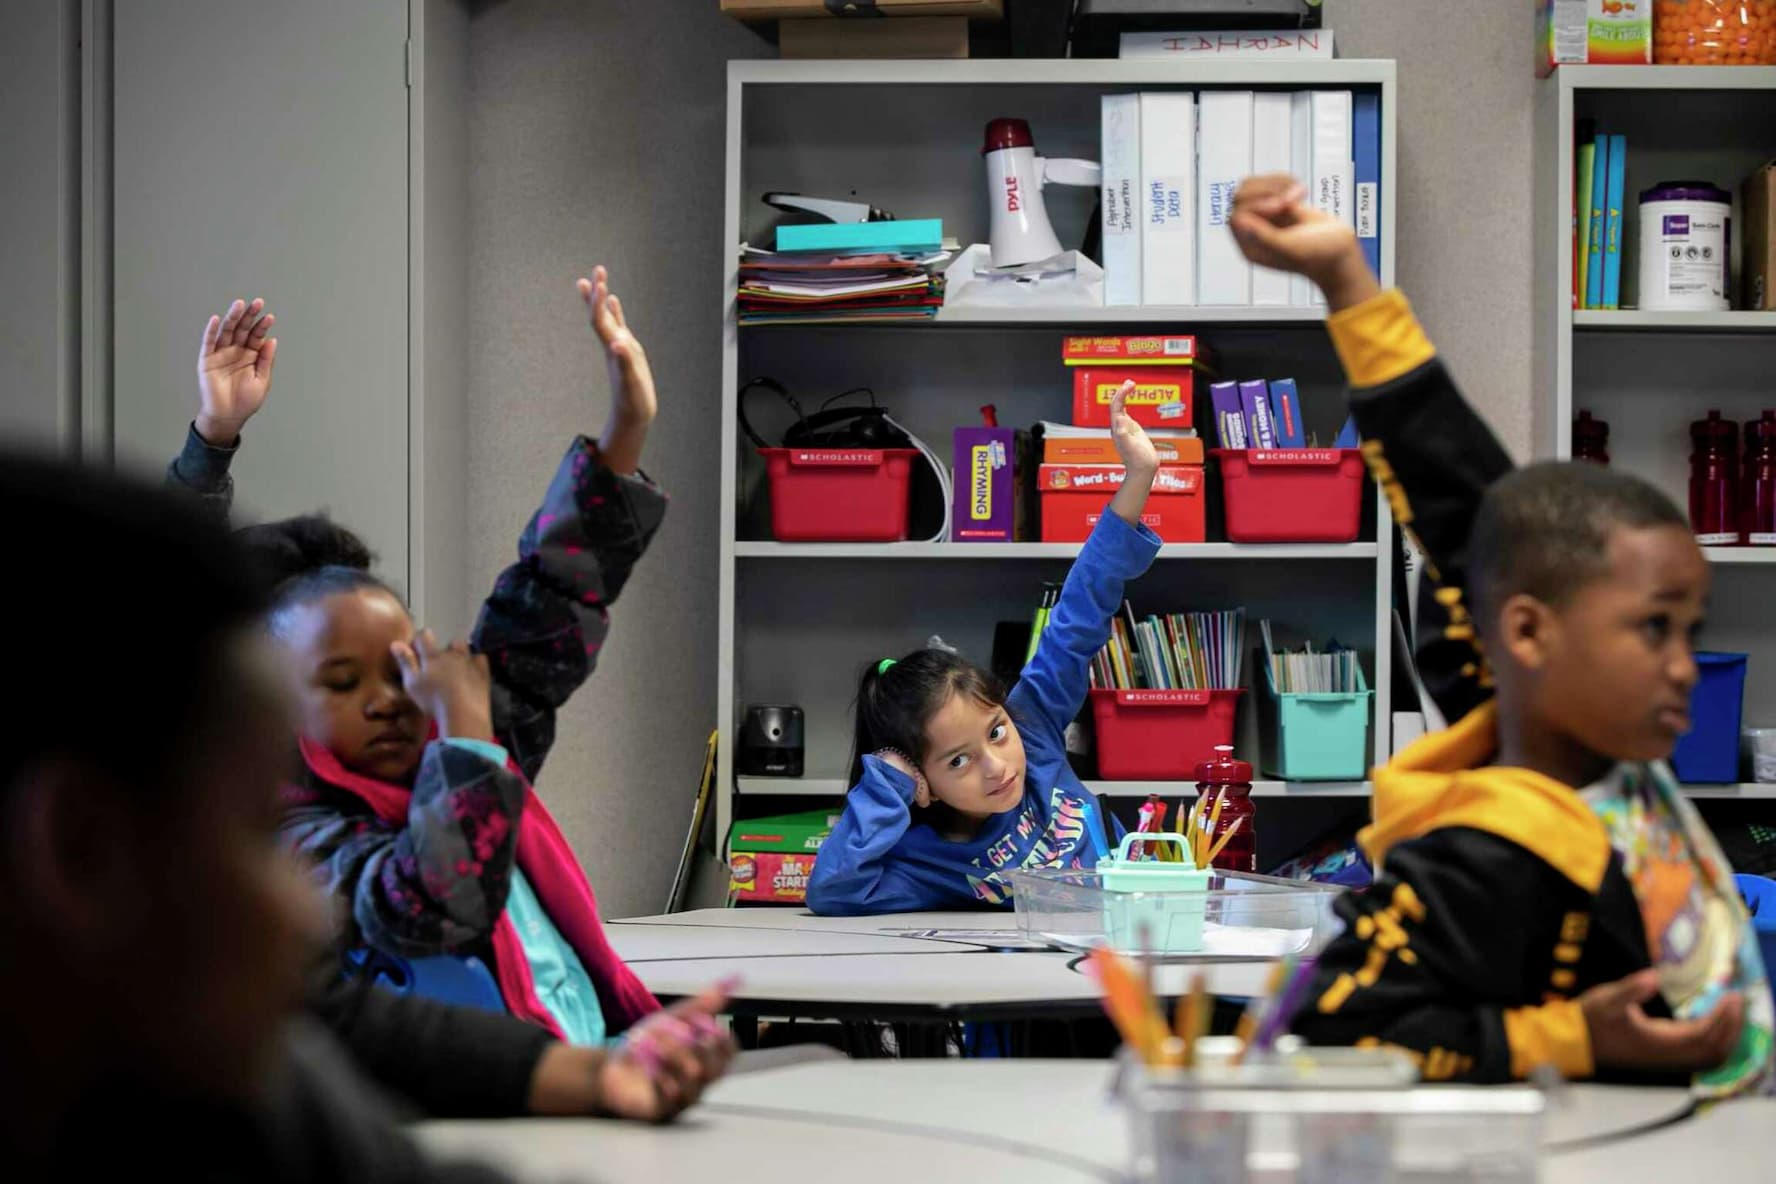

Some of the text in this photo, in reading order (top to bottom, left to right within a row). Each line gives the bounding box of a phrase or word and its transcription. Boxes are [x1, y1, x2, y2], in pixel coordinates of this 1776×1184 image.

[1006, 176, 1019, 212] PYLE
[1150, 181, 1165, 224] Student
[1168, 190, 1180, 217] Data
[1209, 182, 1224, 226] Literacy
[1102, 388, 1175, 400] ALPHAET
[1255, 395, 1269, 431] MONEY
[808, 453, 874, 462] SCHOLASTIC
[1265, 452, 1331, 461] SCHOLASTIC
[976, 450, 988, 515] RHYMING
[1135, 693, 1201, 701] SCHOLASTIC
[987, 833, 1019, 868] GET
